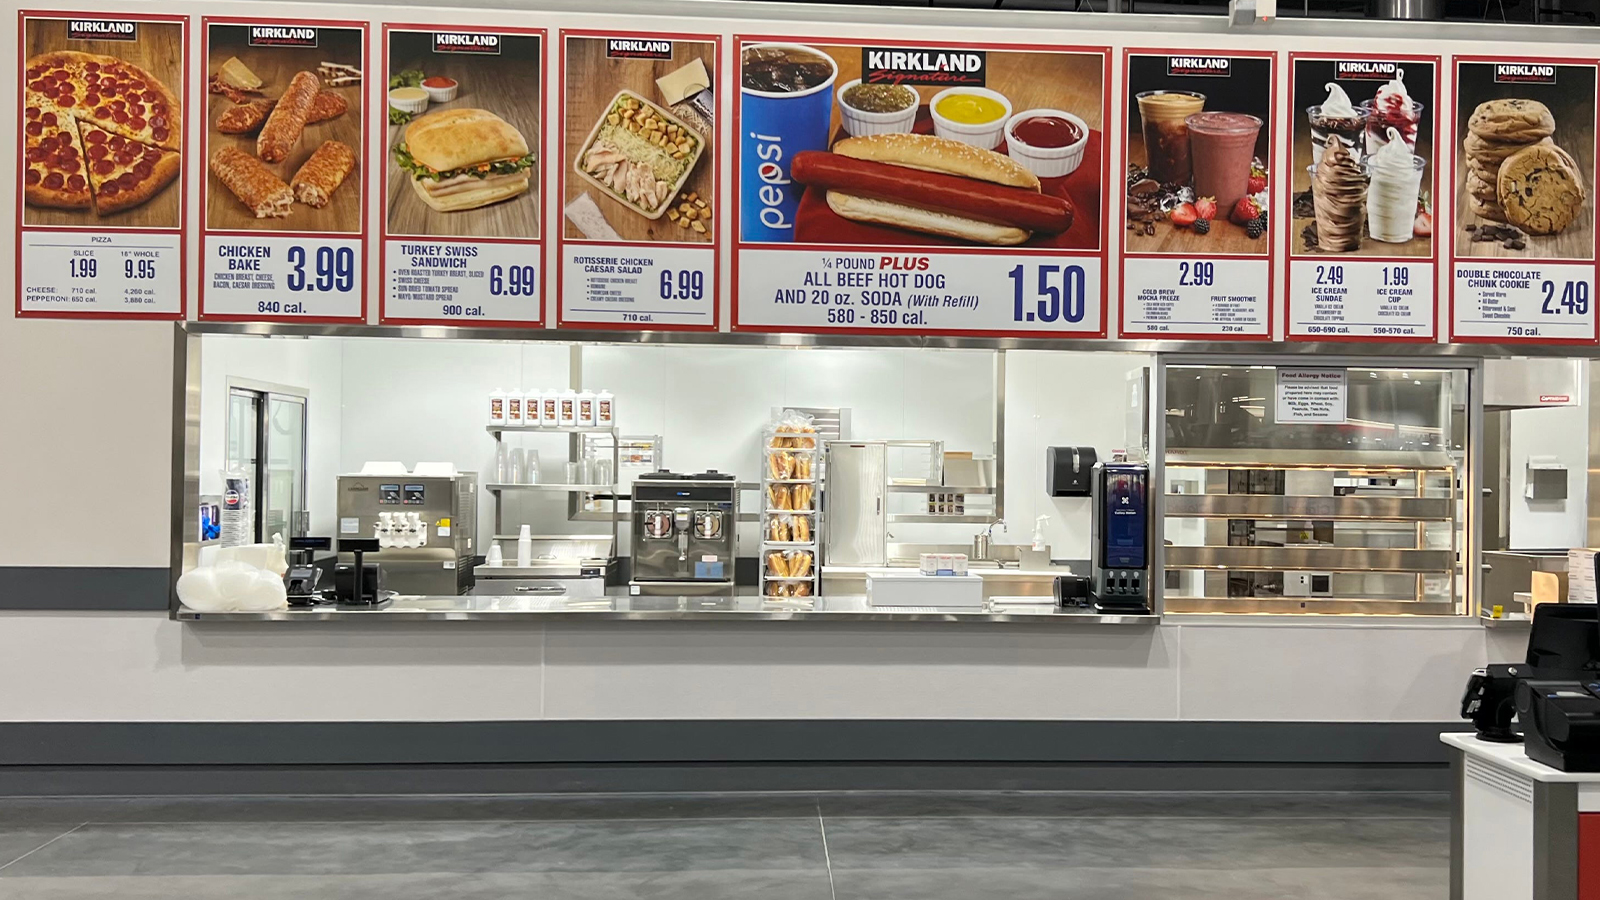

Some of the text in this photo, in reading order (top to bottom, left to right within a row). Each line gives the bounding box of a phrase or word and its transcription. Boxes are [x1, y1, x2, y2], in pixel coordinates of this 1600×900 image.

[71, 22, 134, 33] KIRKLAND
[252, 28, 315, 39] KIRKLAND
[436, 34, 498, 46] KIRKLAND
[610, 40, 670, 52] KIRKLAND
[868, 50, 982, 73] KIRKLAND
[1171, 58, 1228, 69] KIRKLAND
[1338, 63, 1395, 73] KIRKLAND
[1498, 66, 1554, 76] KIRKLAND
[868, 70, 982, 86] Signature
[750, 132, 792, 230] pepsi
[219, 245, 271, 258] CHICKEN
[401, 245, 478, 257] TURKEY SWISS
[70, 258, 97, 278] 1.99
[228, 259, 260, 271] BAKE
[411, 257, 467, 268] SANDWICH
[574, 257, 653, 266] ROTISSERIE CHICKEN
[835, 258, 875, 270] POUND
[879, 257, 930, 270] PLUS
[124, 259, 156, 279] 9.95
[287, 246, 354, 292] 3.99
[1179, 261, 1214, 286] 2.99
[1316, 266, 1344, 285] 2.49
[1457, 269, 1541, 280] DOUBLE CHOCOLATE
[489, 265, 535, 297] 6.99
[804, 273, 946, 289] ALL BEEF HOT DOG
[1383, 267, 1409, 286] 1.99
[660, 270, 703, 300] 6.99
[1468, 279, 1530, 289] CHUNK COOKIE
[775, 290, 979, 310] AND 20 oz. SODA (With Refill)
[1008, 264, 1086, 323] 1.50
[1542, 280, 1588, 315] 2.49
[258, 301, 306, 313] 840 cal.
[443, 305, 485, 316] 900 cal.
[827, 309, 928, 325] 580 850 cal.
[1507, 327, 1541, 336] 750 cal.
